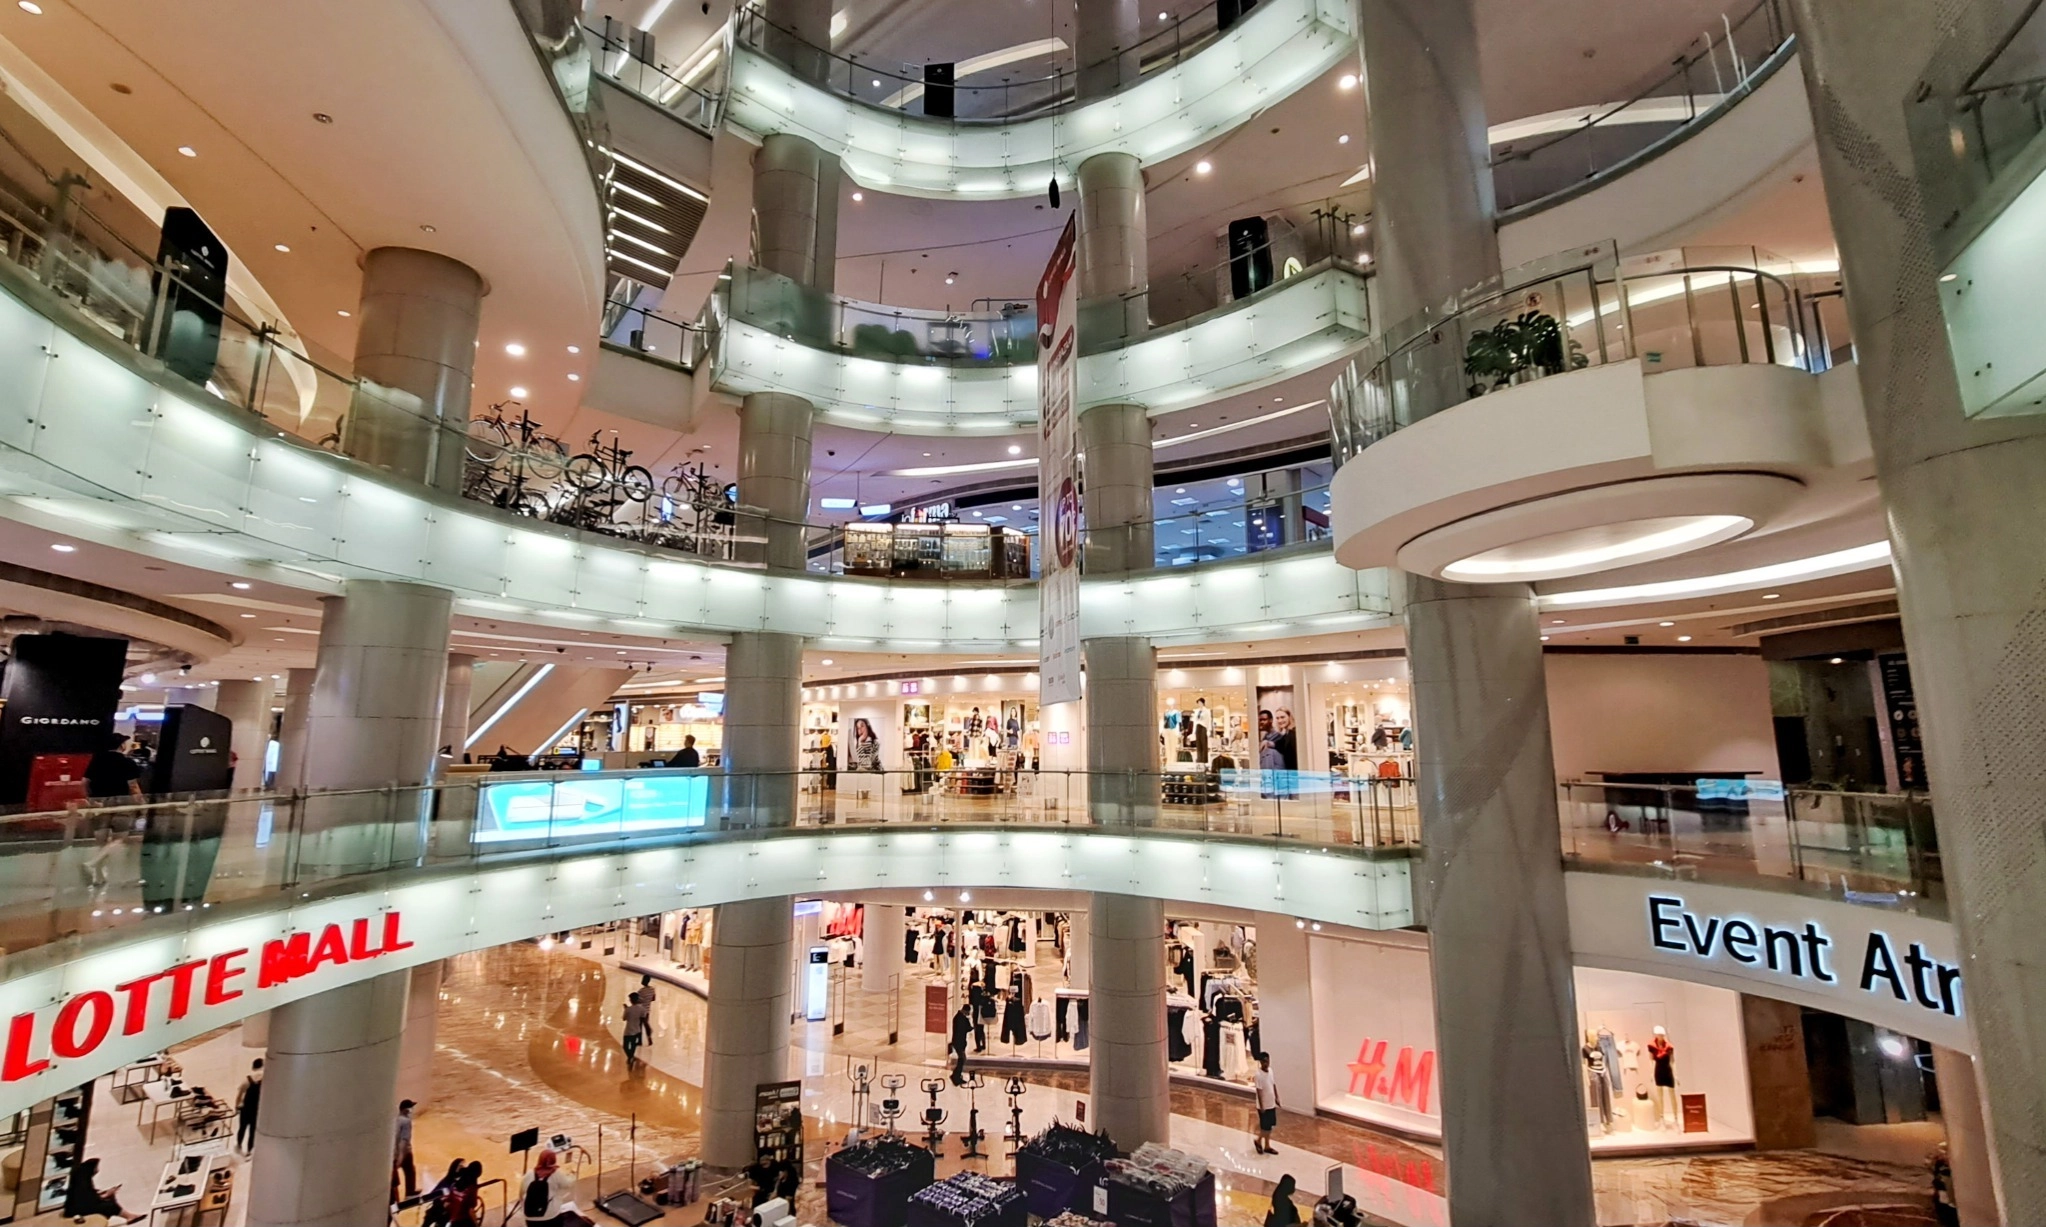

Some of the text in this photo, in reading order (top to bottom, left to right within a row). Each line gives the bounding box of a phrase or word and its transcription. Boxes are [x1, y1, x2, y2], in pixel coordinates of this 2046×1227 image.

[20, 716, 100, 725] GIORDANO
[1649, 897, 1834, 982] Event
[2, 912, 413, 1081] LOTTE MALL
[1346, 1036, 1435, 1114] H&M
